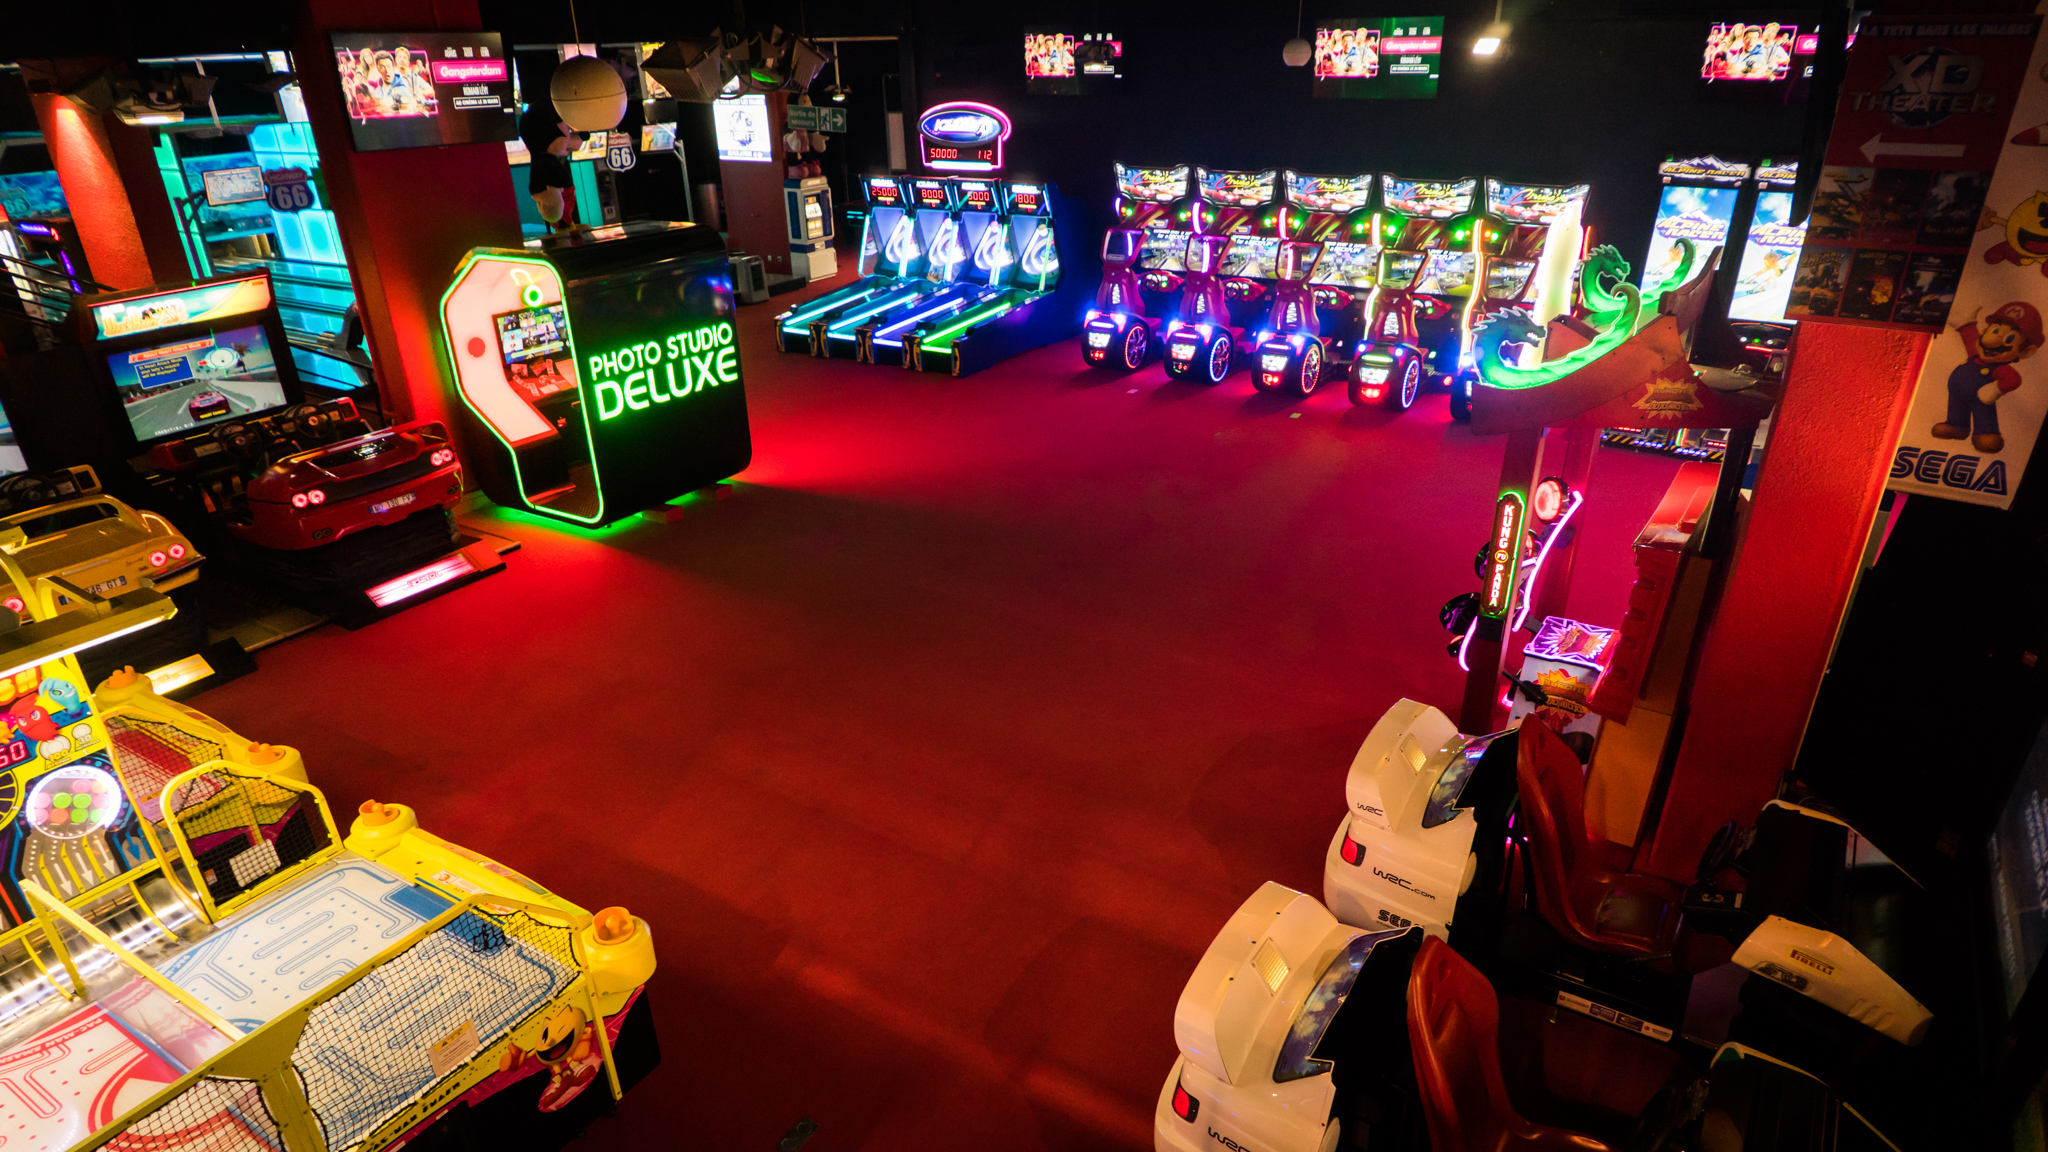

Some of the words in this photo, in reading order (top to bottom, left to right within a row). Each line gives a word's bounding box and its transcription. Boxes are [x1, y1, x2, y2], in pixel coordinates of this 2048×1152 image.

[1386, 40, 1437, 52] Gangsterdam
[440, 64, 502, 79] Gangsterdam
[1879, 54, 1985, 95] XD
[1848, 91, 1998, 114] THEATER
[789, 108, 806, 117] Sortie
[611, 147, 632, 168] 66
[930, 148, 958, 159] 50000
[1663, 166, 1705, 174] ALPINE
[1706, 169, 1746, 177] RACER
[1759, 171, 1796, 179] ALPIN
[275, 184, 308, 209] 66
[872, 187, 898, 198] 25000
[921, 189, 944, 199] 8000
[967, 191, 990, 201] 5000
[1015, 194, 1035, 204] 1800
[1658, 219, 1725, 232] ALPINE
[1752, 226, 1806, 238] ALPIN
[1665, 228, 1726, 240] RACER
[1760, 235, 1804, 247] RAC
[143, 351, 158, 359] About
[158, 348, 172, 356] Heart
[173, 345, 188, 353] Attack
[589, 341, 662, 381] PHOTO
[666, 322, 733, 359] STUDIO
[594, 345, 739, 421] DELUXE
[1889, 446, 2008, 496] SEGA
[1498, 504, 1515, 549] KUNG
[1496, 553, 1507, 561] FU
[107, 579, 119, 589] GT
[1489, 563, 1505, 608] PANDA
[79, 734, 91, 745] 30
[49, 748, 69, 761] 100
[1357, 803, 1384, 816] WRC
[1378, 909, 1412, 927] SEG
[1790, 949, 1835, 976] PIRELLI
[45, 1018, 104, 1048] PAC-MAN
